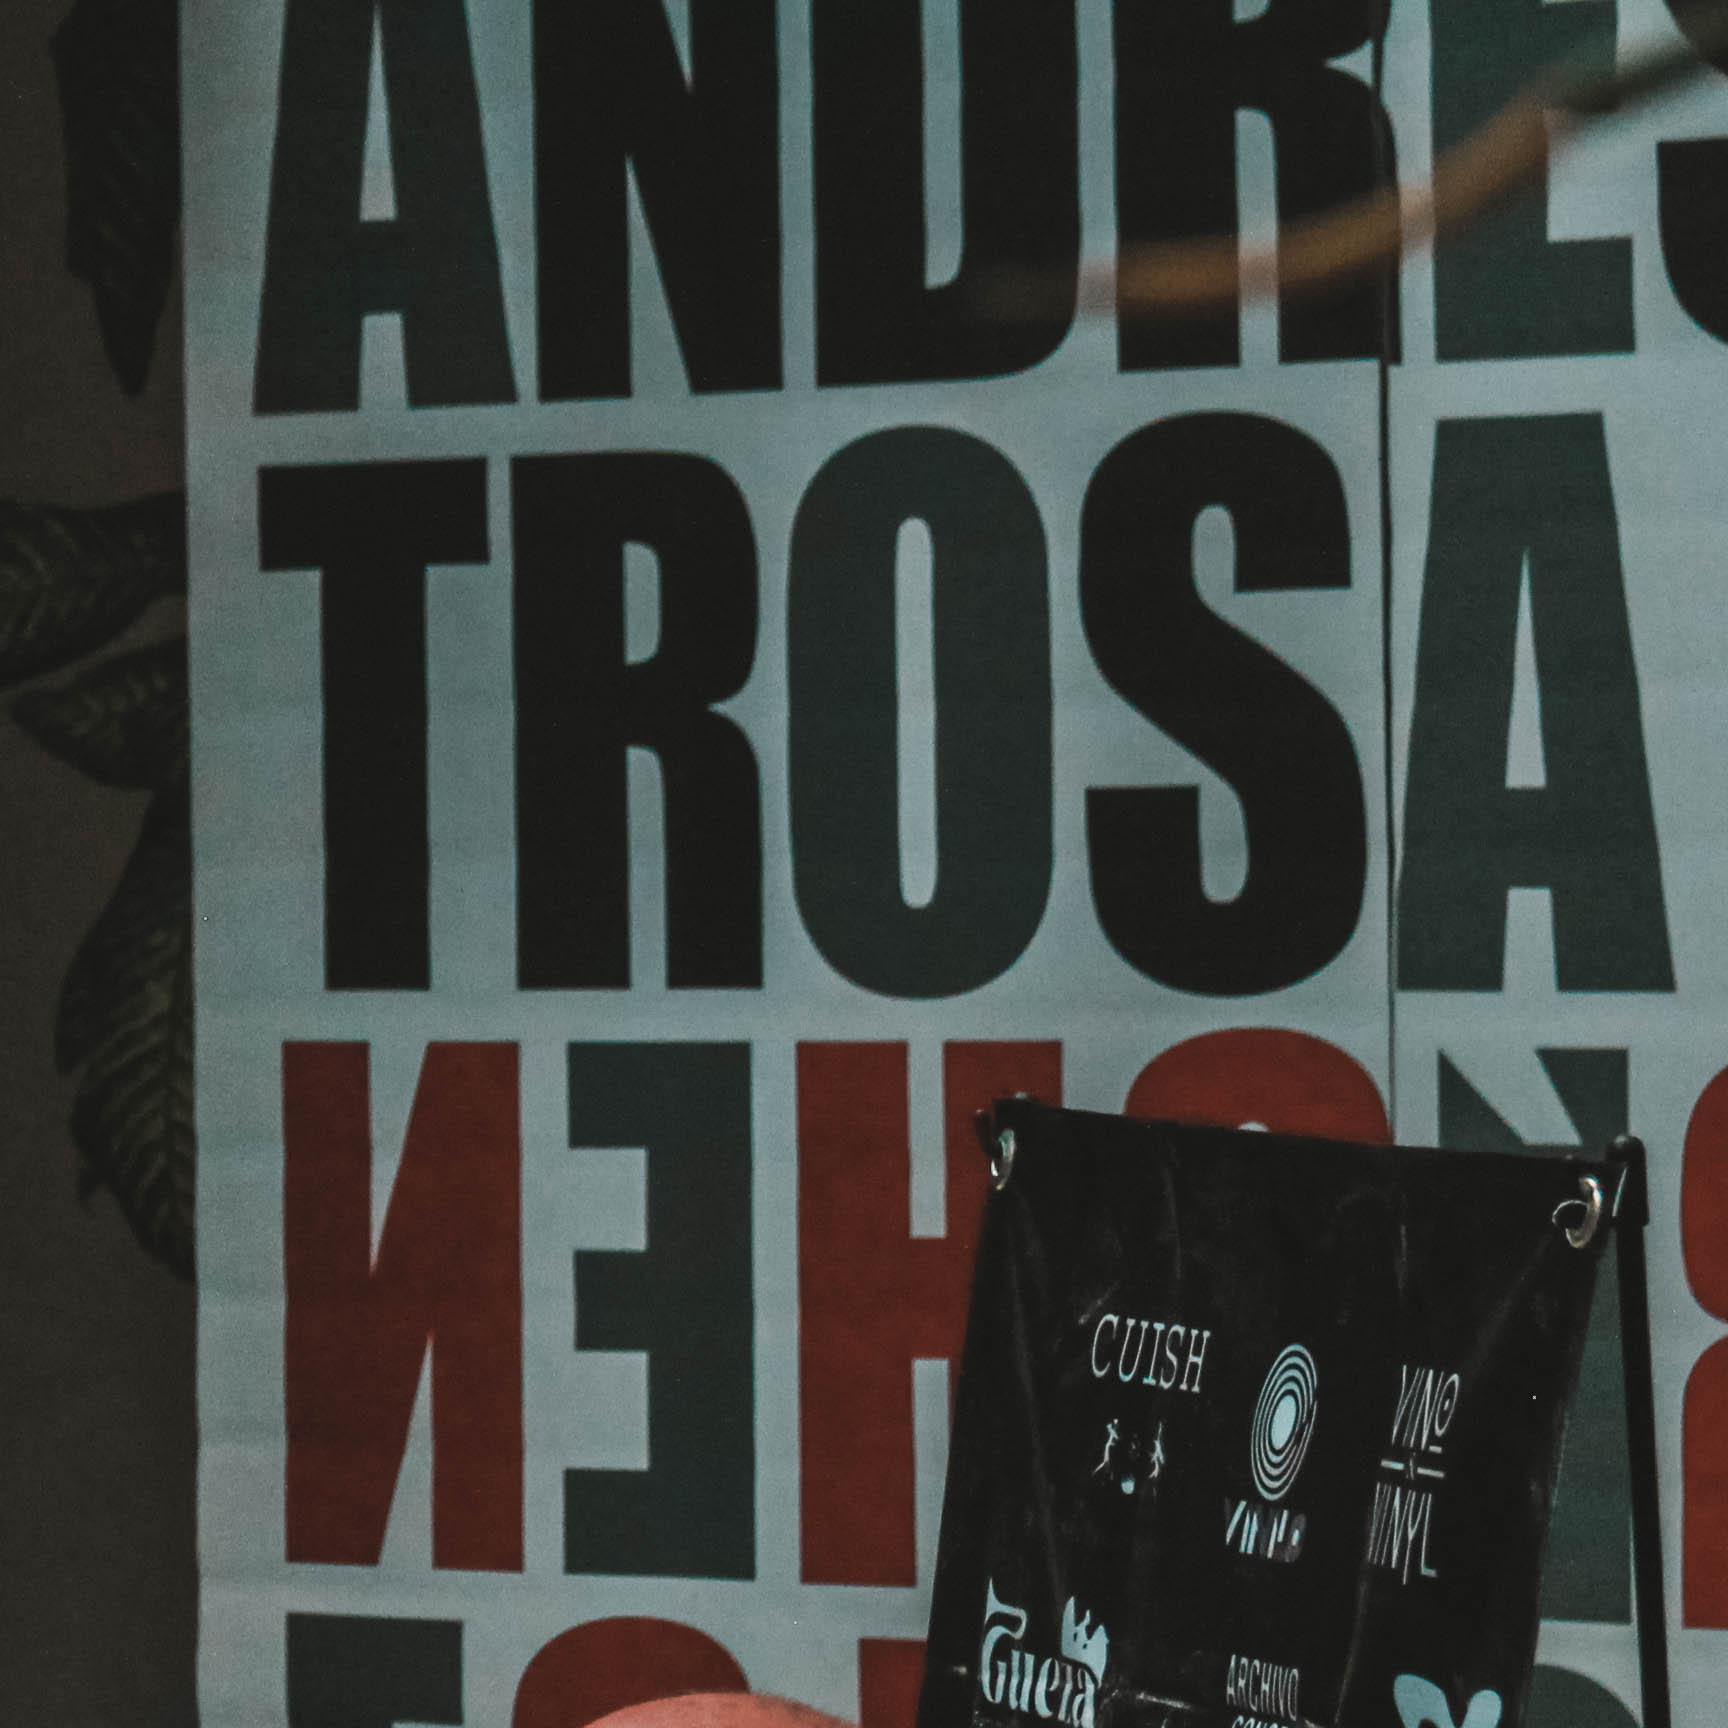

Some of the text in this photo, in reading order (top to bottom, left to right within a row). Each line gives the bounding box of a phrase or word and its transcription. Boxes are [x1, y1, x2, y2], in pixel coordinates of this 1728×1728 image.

[253, 0, 1728, 416] ANDRE
[256, 410, 1678, 1000] TROSA
[1091, 1313, 1211, 1394] CUISH
[1367, 1481, 1438, 1585] VINYL
[1226, 1653, 1299, 1722] ARCHIVO
